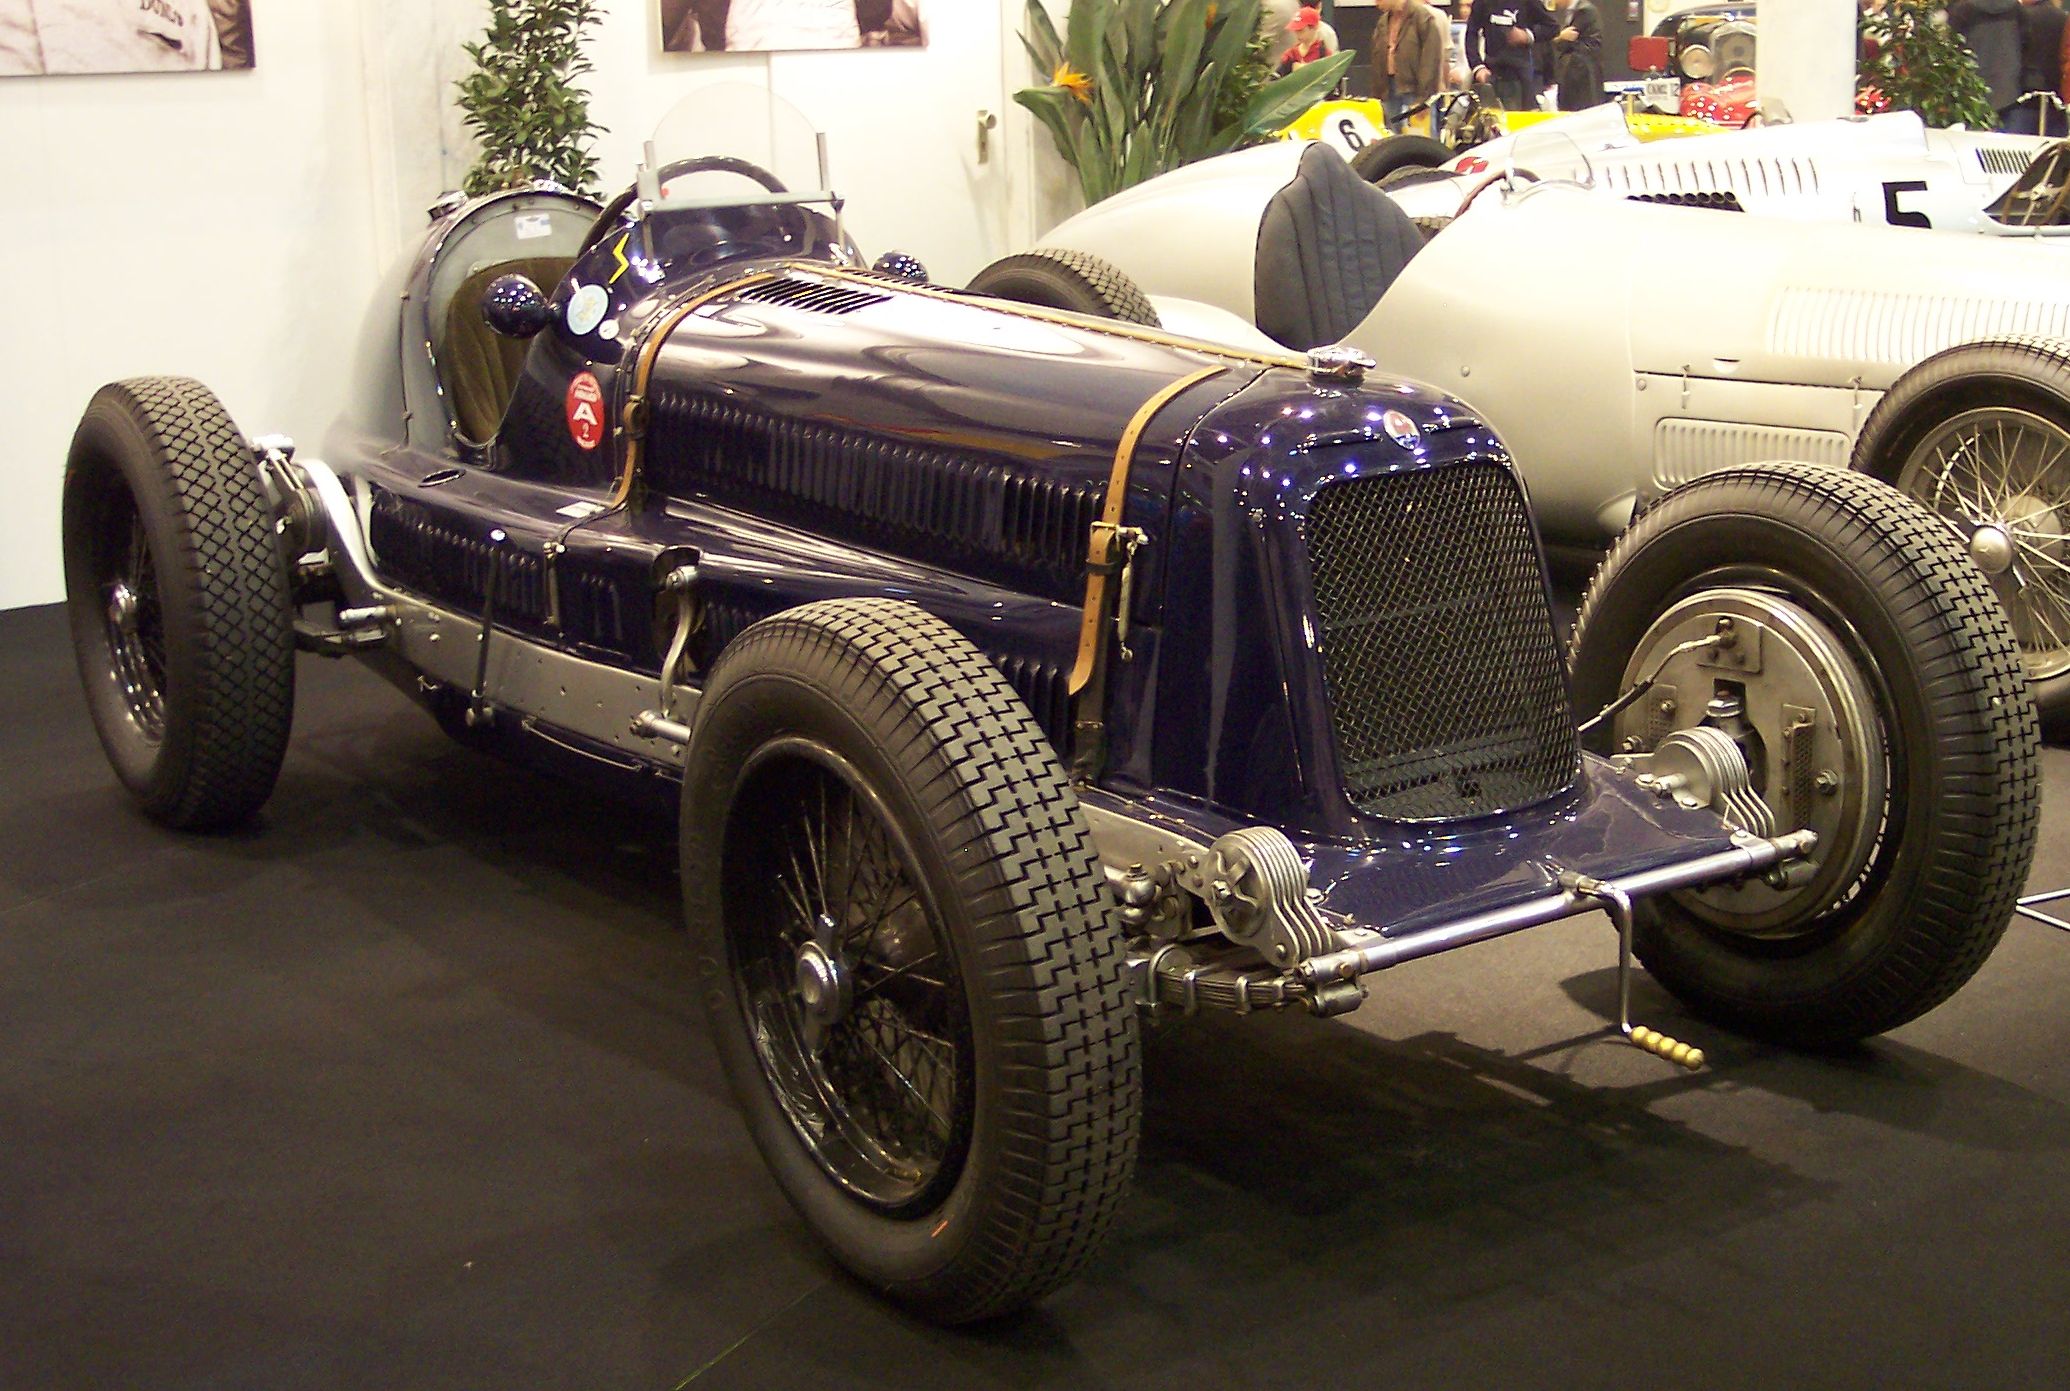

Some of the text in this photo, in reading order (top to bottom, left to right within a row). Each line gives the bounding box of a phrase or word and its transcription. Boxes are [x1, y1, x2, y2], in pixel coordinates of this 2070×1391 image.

[1338, 119, 1364, 151] 6
[1881, 181, 1932, 229] 5
[572, 401, 598, 425] A
